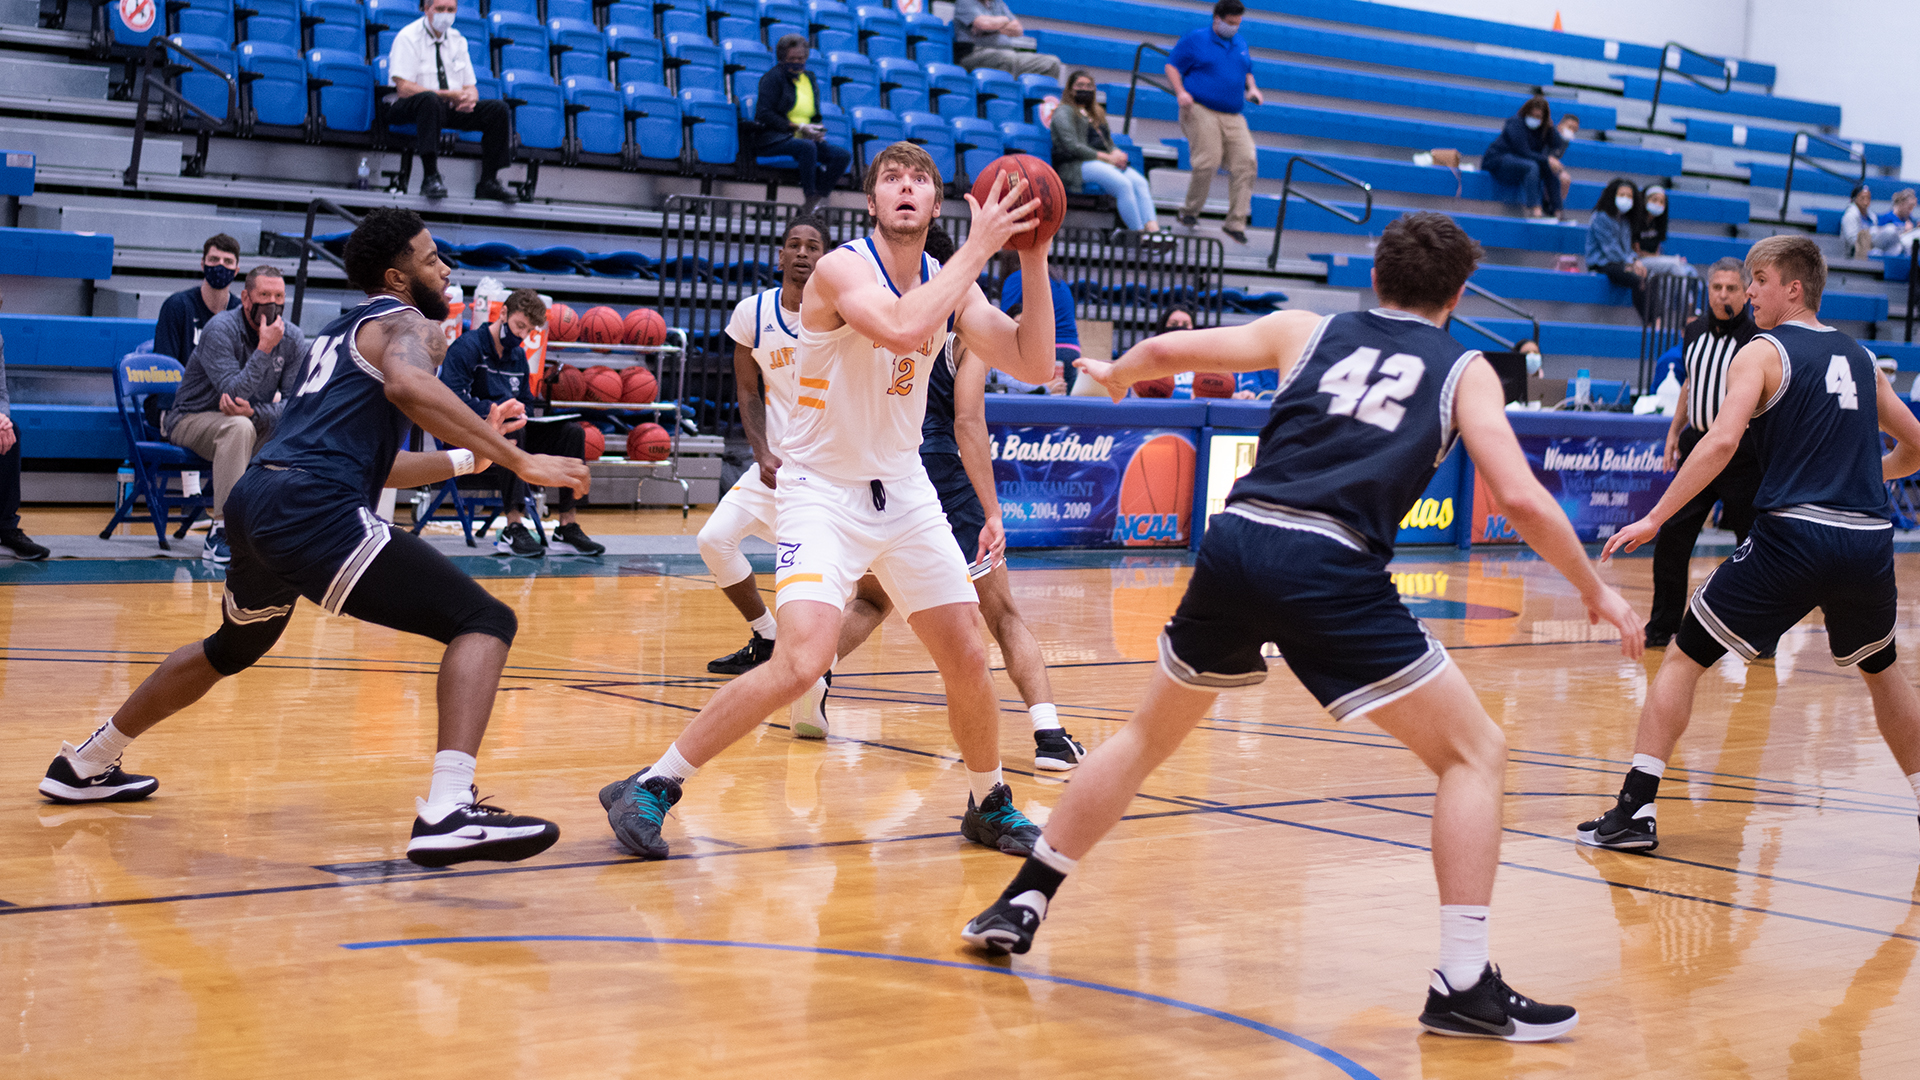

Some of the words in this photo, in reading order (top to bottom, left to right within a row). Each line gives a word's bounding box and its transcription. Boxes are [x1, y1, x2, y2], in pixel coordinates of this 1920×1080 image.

[886, 354, 916, 396] 12
[1317, 345, 1426, 433] 42
[1824, 354, 1859, 411] 4
[1002, 433, 1115, 462] Basketball
[1543, 446, 1600, 471] Women's
[1600, 446, 1664, 473] Basketba
[1001, 480, 1095, 498] TOURNAMENT
[1028, 502, 1061, 522] 2004,
[1062, 501, 1092, 519] 2009
[1400, 497, 1455, 530] nas
[1112, 513, 1178, 541] NCAA
[1483, 514, 1518, 539] NC
